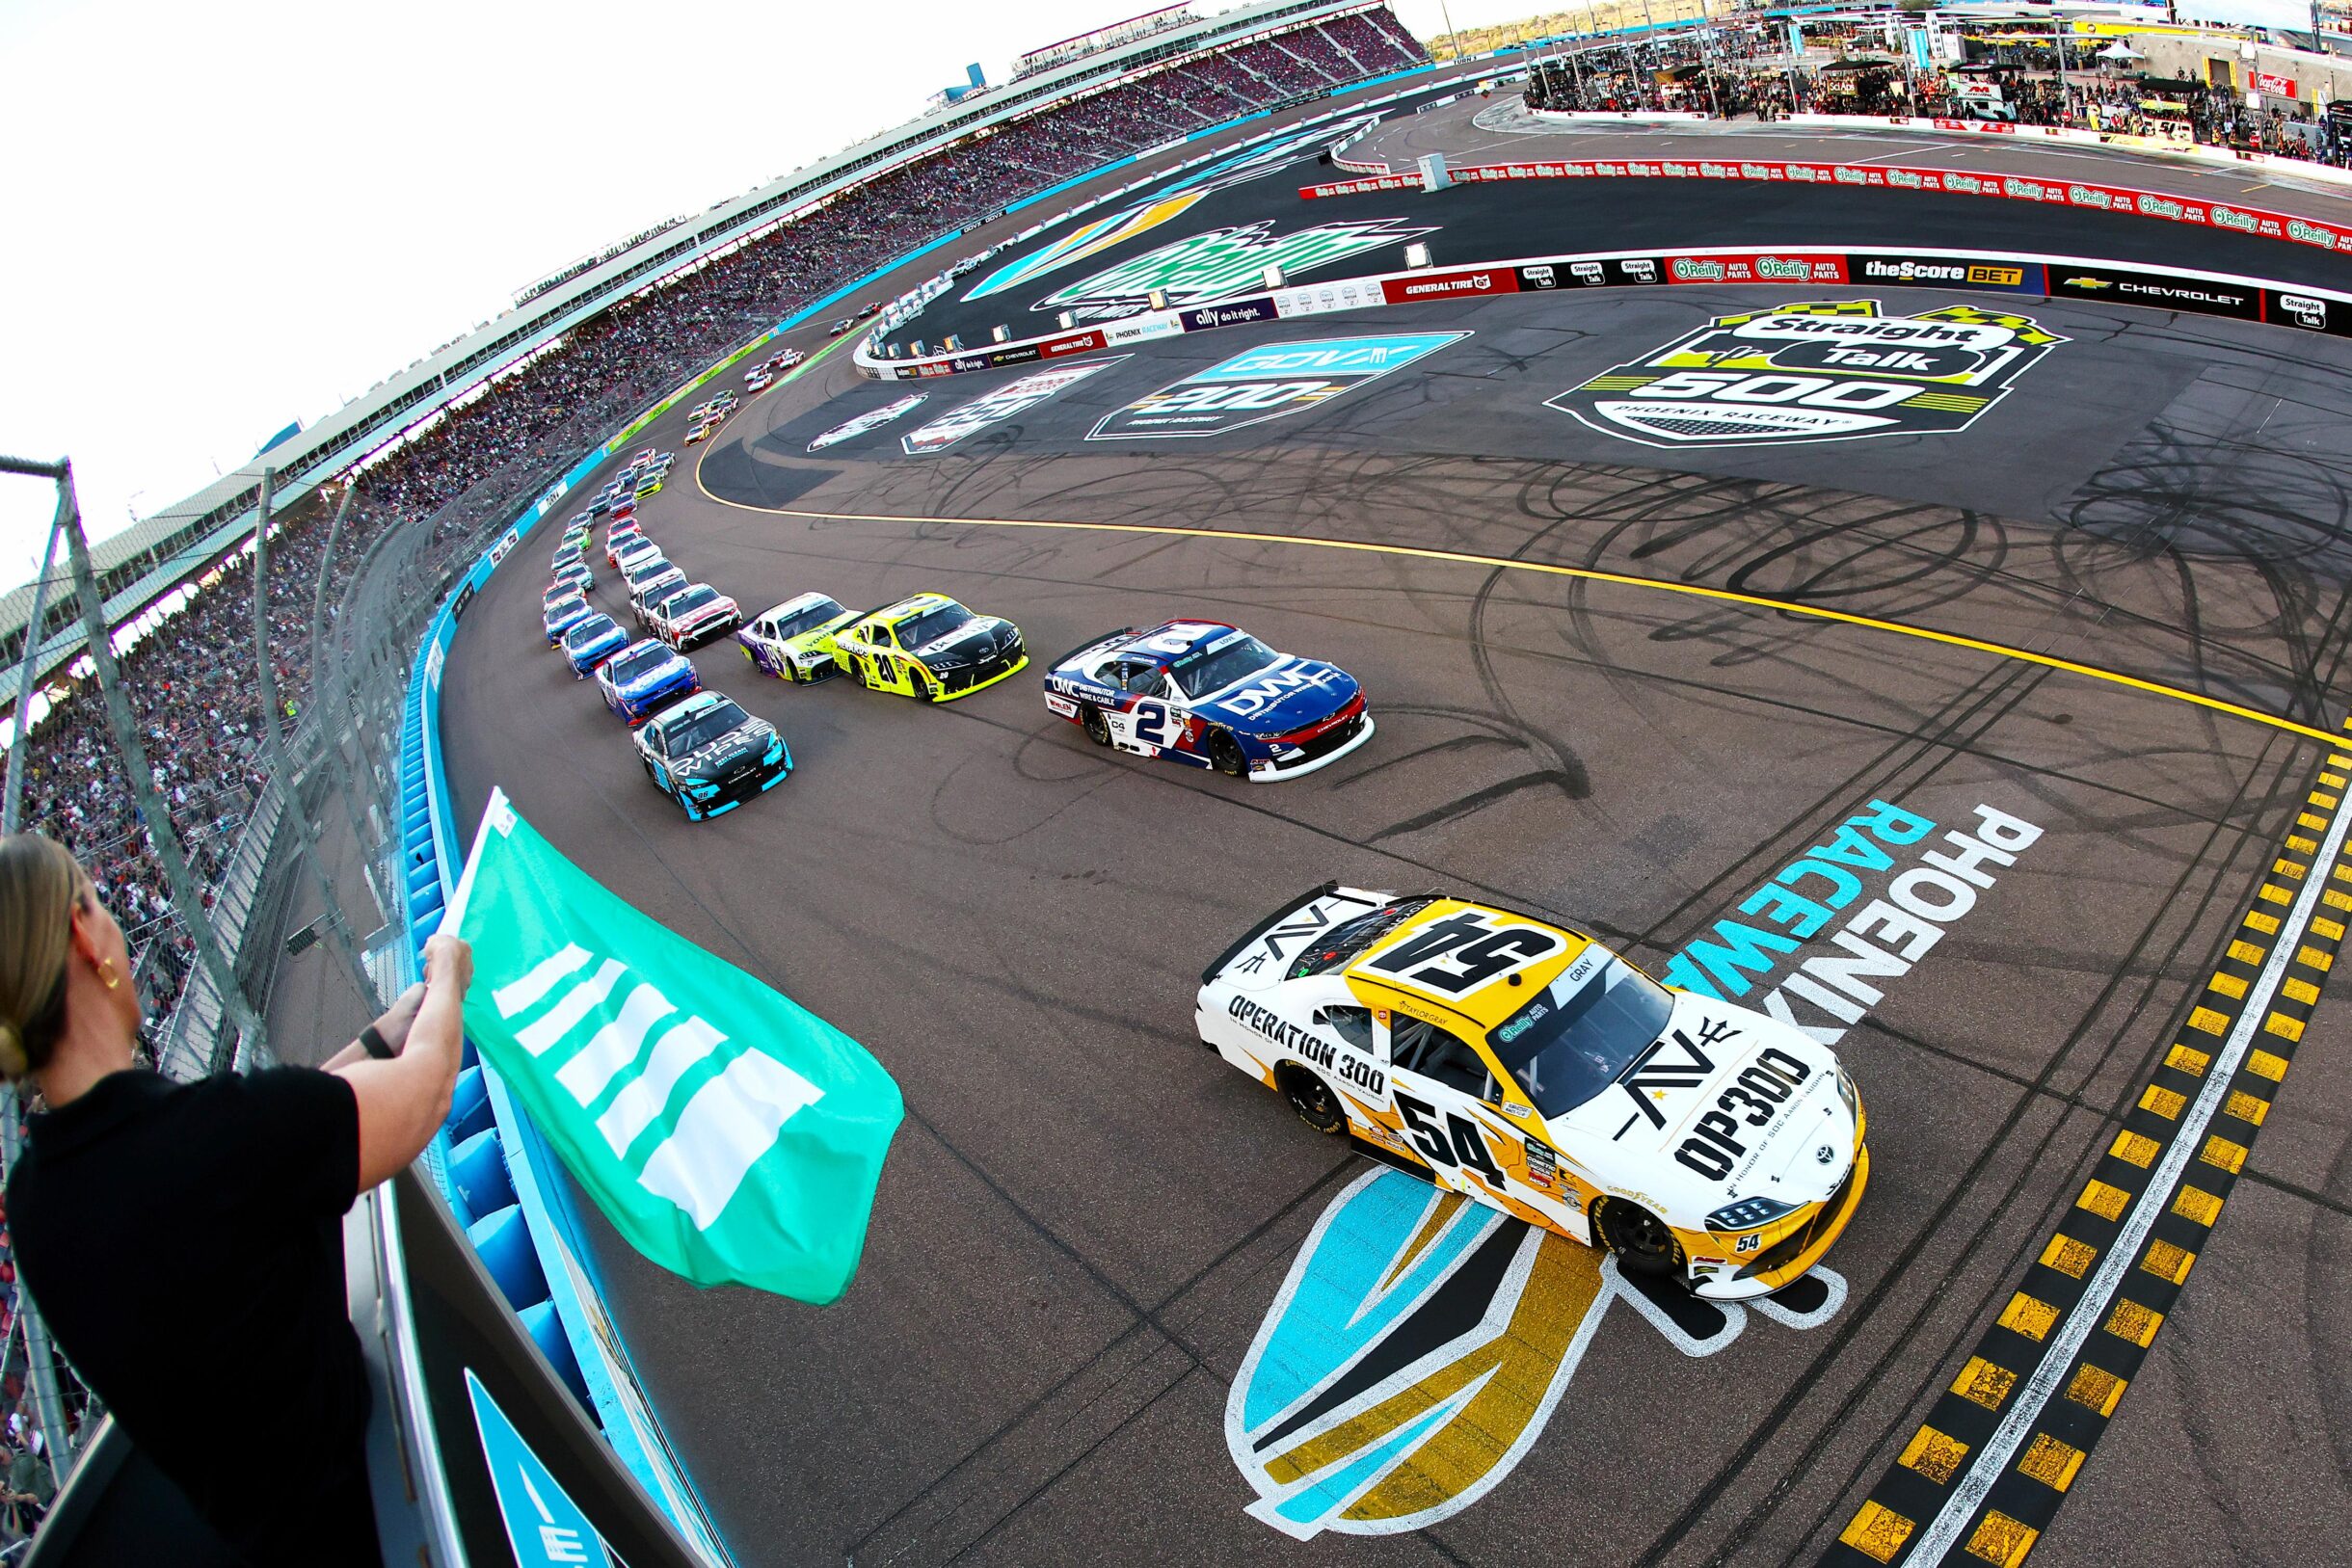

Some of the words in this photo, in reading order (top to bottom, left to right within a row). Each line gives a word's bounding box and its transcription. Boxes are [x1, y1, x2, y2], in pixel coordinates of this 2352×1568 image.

[1834, 167, 1866, 185] O'Reilly
[1886, 170, 1921, 189] O'Reilly
[1943, 173, 1980, 193] O'Reilly
[2005, 179, 2044, 200] O'Reilly
[2069, 185, 2111, 209] O'Reilly
[2138, 195, 2182, 220] O'Reilly
[2184, 213, 2205, 222] PARTS
[2186, 206, 2204, 215] AUTO
[2211, 206, 2258, 232] O'Reilly
[2261, 220, 2279, 228] AUTO
[2259, 226, 2281, 235] PARTS
[2286, 220, 2337, 249] O'Reilly
[2339, 241, 2352, 251] PAR
[1574, 264, 1598, 275] Straight
[1625, 262, 1650, 272] Straight
[1639, 272, 1652, 281] Talk
[1673, 258, 1724, 281] O'Reilly
[1726, 270, 1751, 279] PARTS
[1756, 257, 1810, 281] O'Reilly
[1814, 270, 1839, 279] PARTS
[1866, 260, 1964, 279] theScore
[1972, 268, 2018, 282] BET
[1405, 281, 1450, 295] GENERAL
[1451, 279, 1473, 291] TIRE
[1588, 275, 1602, 283] Talk
[2119, 283, 2244, 306] CHEVROLET
[2285, 299, 2321, 310] Straight
[1195, 311, 1218, 328] ally
[1221, 311, 1230, 321] do
[1230, 310, 1238, 320] it
[1238, 306, 1261, 321] right.
[2302, 314, 2320, 326] Talk
[1115, 328, 1141, 339] PHOENIX
[1141, 324, 1168, 334] RACEWAY
[1765, 317, 1983, 342] Straight
[1004, 349, 1036, 359] CHEVROLET
[1825, 346, 1942, 372] Talk
[1133, 381, 1332, 415] 200
[1629, 372, 1925, 410] 500
[1614, 405, 1716, 420] PHOENIX
[1724, 410, 1839, 426] RACEWAY
[1219, 636, 1236, 645] LOVE
[873, 653, 898, 685] 20
[1080, 684, 1115, 697] DISTRIBUTOR
[1080, 693, 1093, 702] WIRE
[1097, 696, 1115, 705] CABLE
[1217, 661, 1332, 717] DWC
[1248, 691, 1296, 721] DISTRIBUTOR
[1136, 703, 1165, 745] 2
[1317, 715, 1348, 733] CHEVROLET
[676, 725, 772, 777] WIPES
[1269, 744, 1280, 753] 2
[1661, 799, 1938, 1003] RACEWA
[1763, 803, 2045, 1046] PHOENIX
[1369, 913, 1557, 994] 54
[1569, 959, 1594, 982] GRAY
[1404, 1004, 1429, 1021] TAYLOR
[1429, 1015, 1448, 1025] GRAY
[1529, 1003, 1542, 1016] AUTO
[1532, 1007, 1549, 1022] PARTS
[1499, 1016, 1533, 1043] O'Reilly
[1228, 995, 1338, 1071] OPERATION
[1338, 1054, 1384, 1095] 300
[1240, 1023, 1263, 1038] HONOR
[1358, 1088, 1384, 1103] VAUGHN
[1674, 1048, 1811, 1182] OP300
[1737, 1152, 1760, 1183] HONOR
[1760, 1138, 1770, 1155] OF
[1768, 1120, 1785, 1139] SOC
[1783, 1097, 1804, 1120] AARON
[1803, 1072, 1826, 1097] VAUGHN
[1393, 1089, 1507, 1191] 54
[1527, 1156, 1557, 1173] COMETIC
[1606, 1185, 1669, 1214] GOODYEAR
[1736, 1234, 1760, 1253] 54
